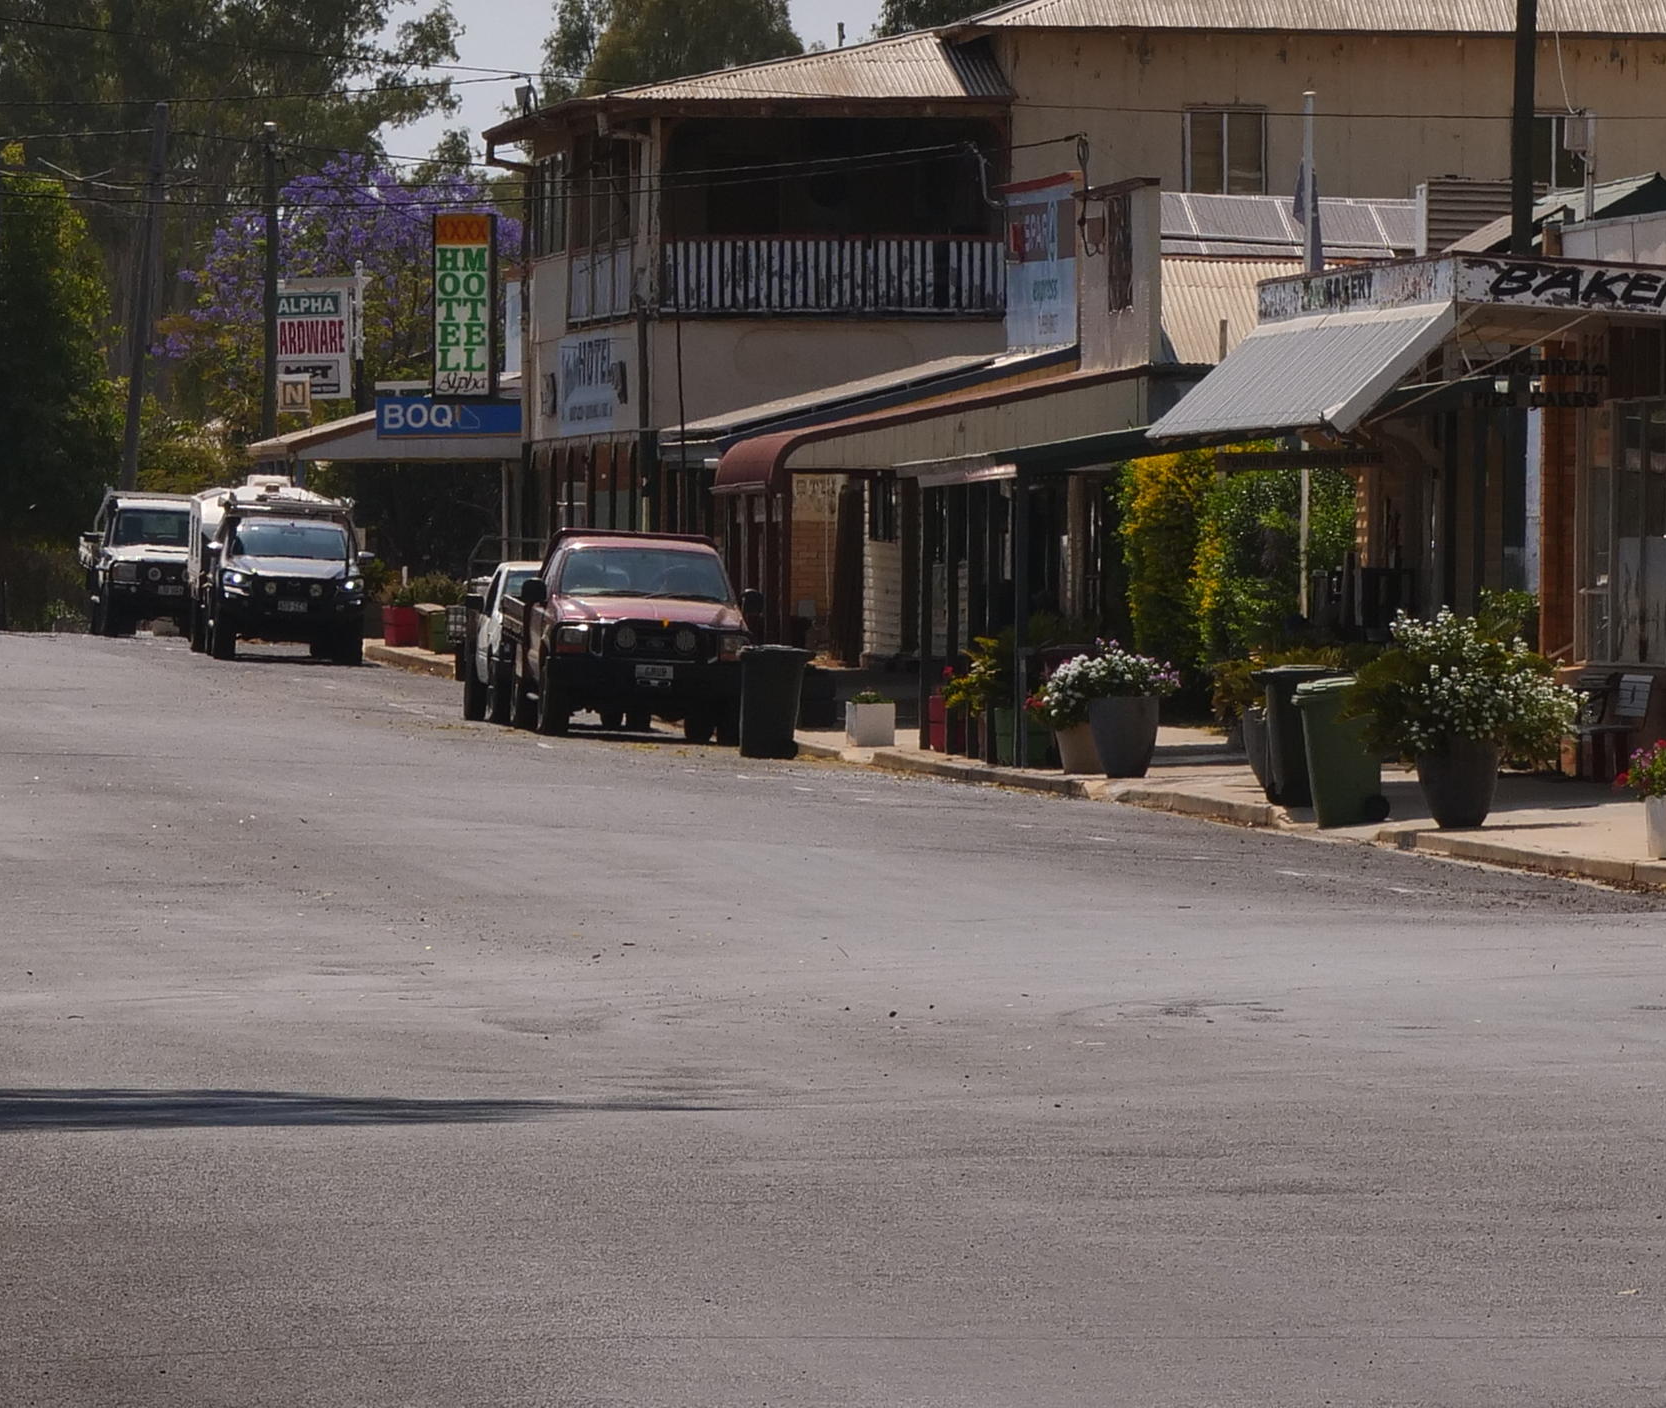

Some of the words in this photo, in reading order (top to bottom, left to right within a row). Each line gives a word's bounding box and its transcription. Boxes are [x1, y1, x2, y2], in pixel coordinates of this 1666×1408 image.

[437, 220, 487, 241] XXXX
[278, 297, 336, 314] ALPHA
[437, 247, 462, 372] HOTEL
[462, 247, 487, 372] MOTEL
[278, 320, 346, 355] ARDWARE
[437, 372, 487, 394] Alpha
[383, 403, 453, 430] BOQ
